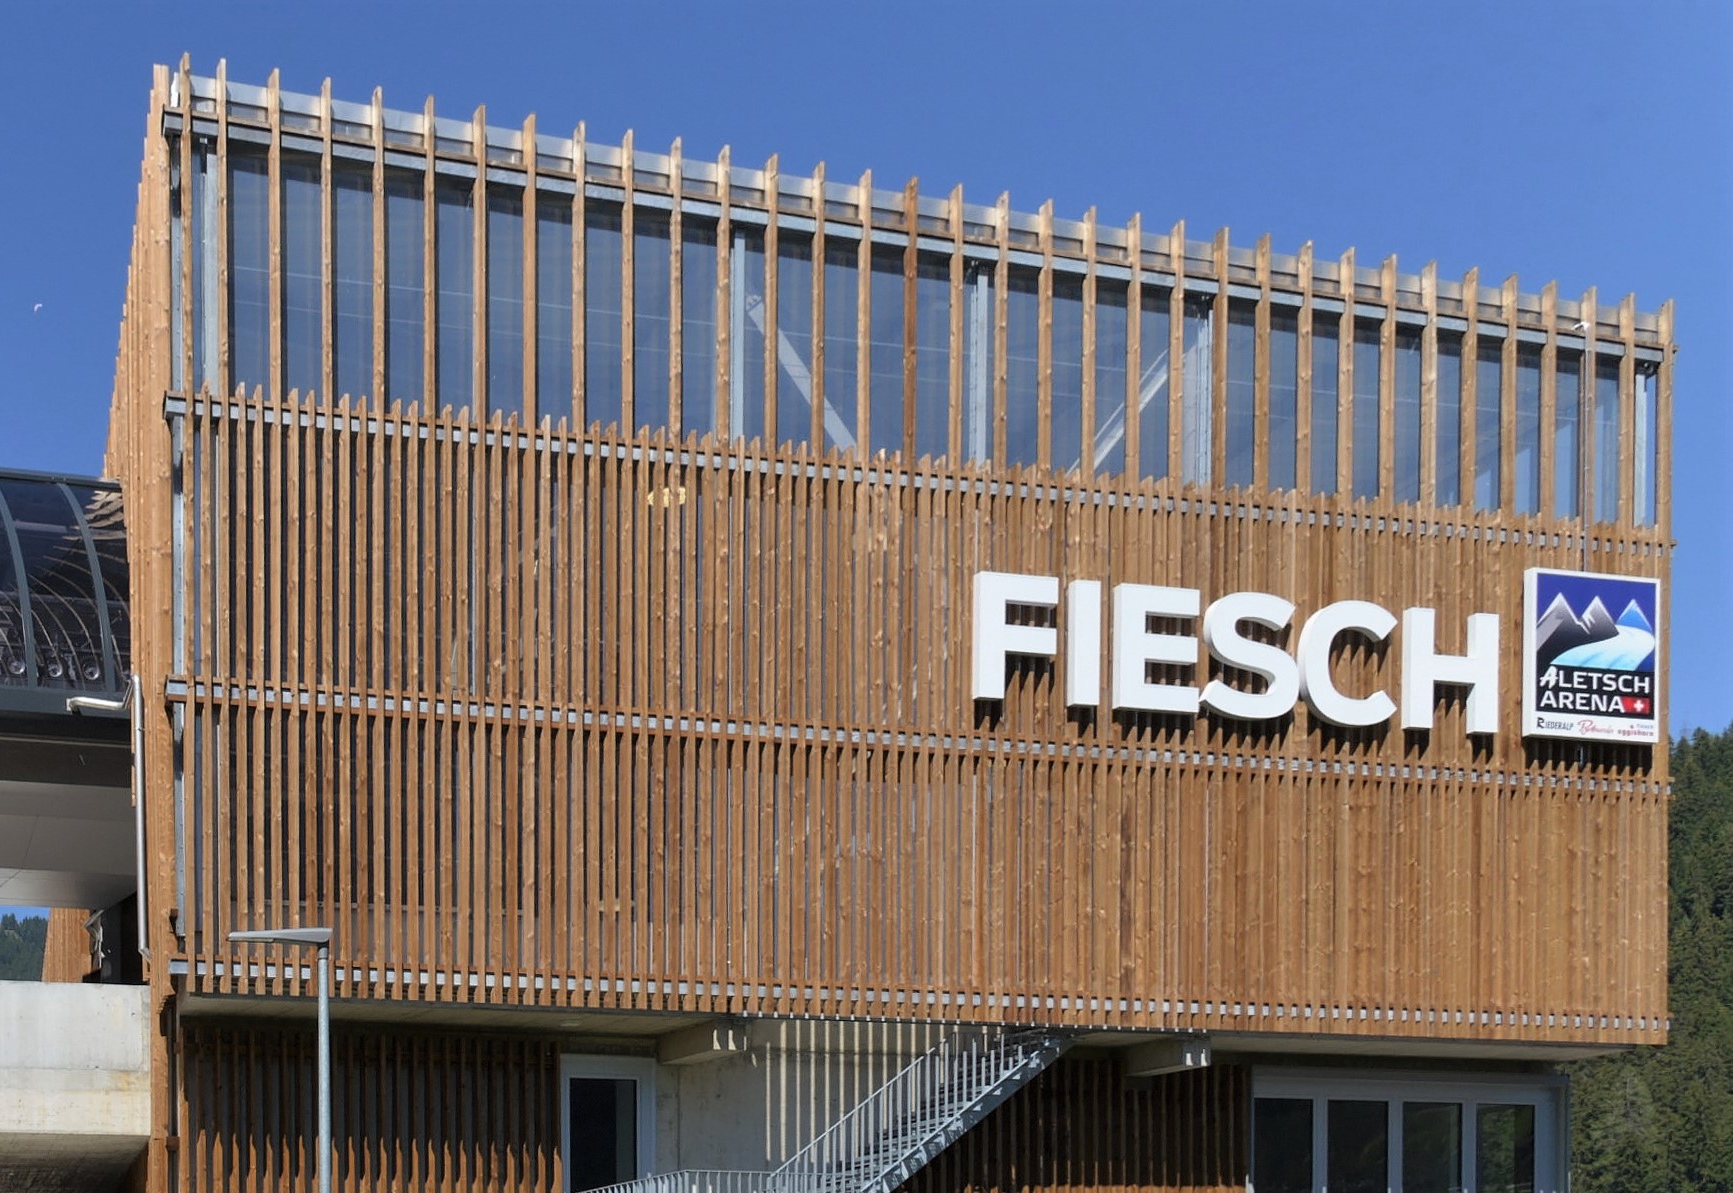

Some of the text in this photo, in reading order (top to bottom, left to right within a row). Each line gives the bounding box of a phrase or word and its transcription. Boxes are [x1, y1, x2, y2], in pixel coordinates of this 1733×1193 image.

[972, 571, 1499, 734] FIESCH
[1539, 665, 1650, 694] ALETSCH
[1539, 690, 1626, 713] ARENA
